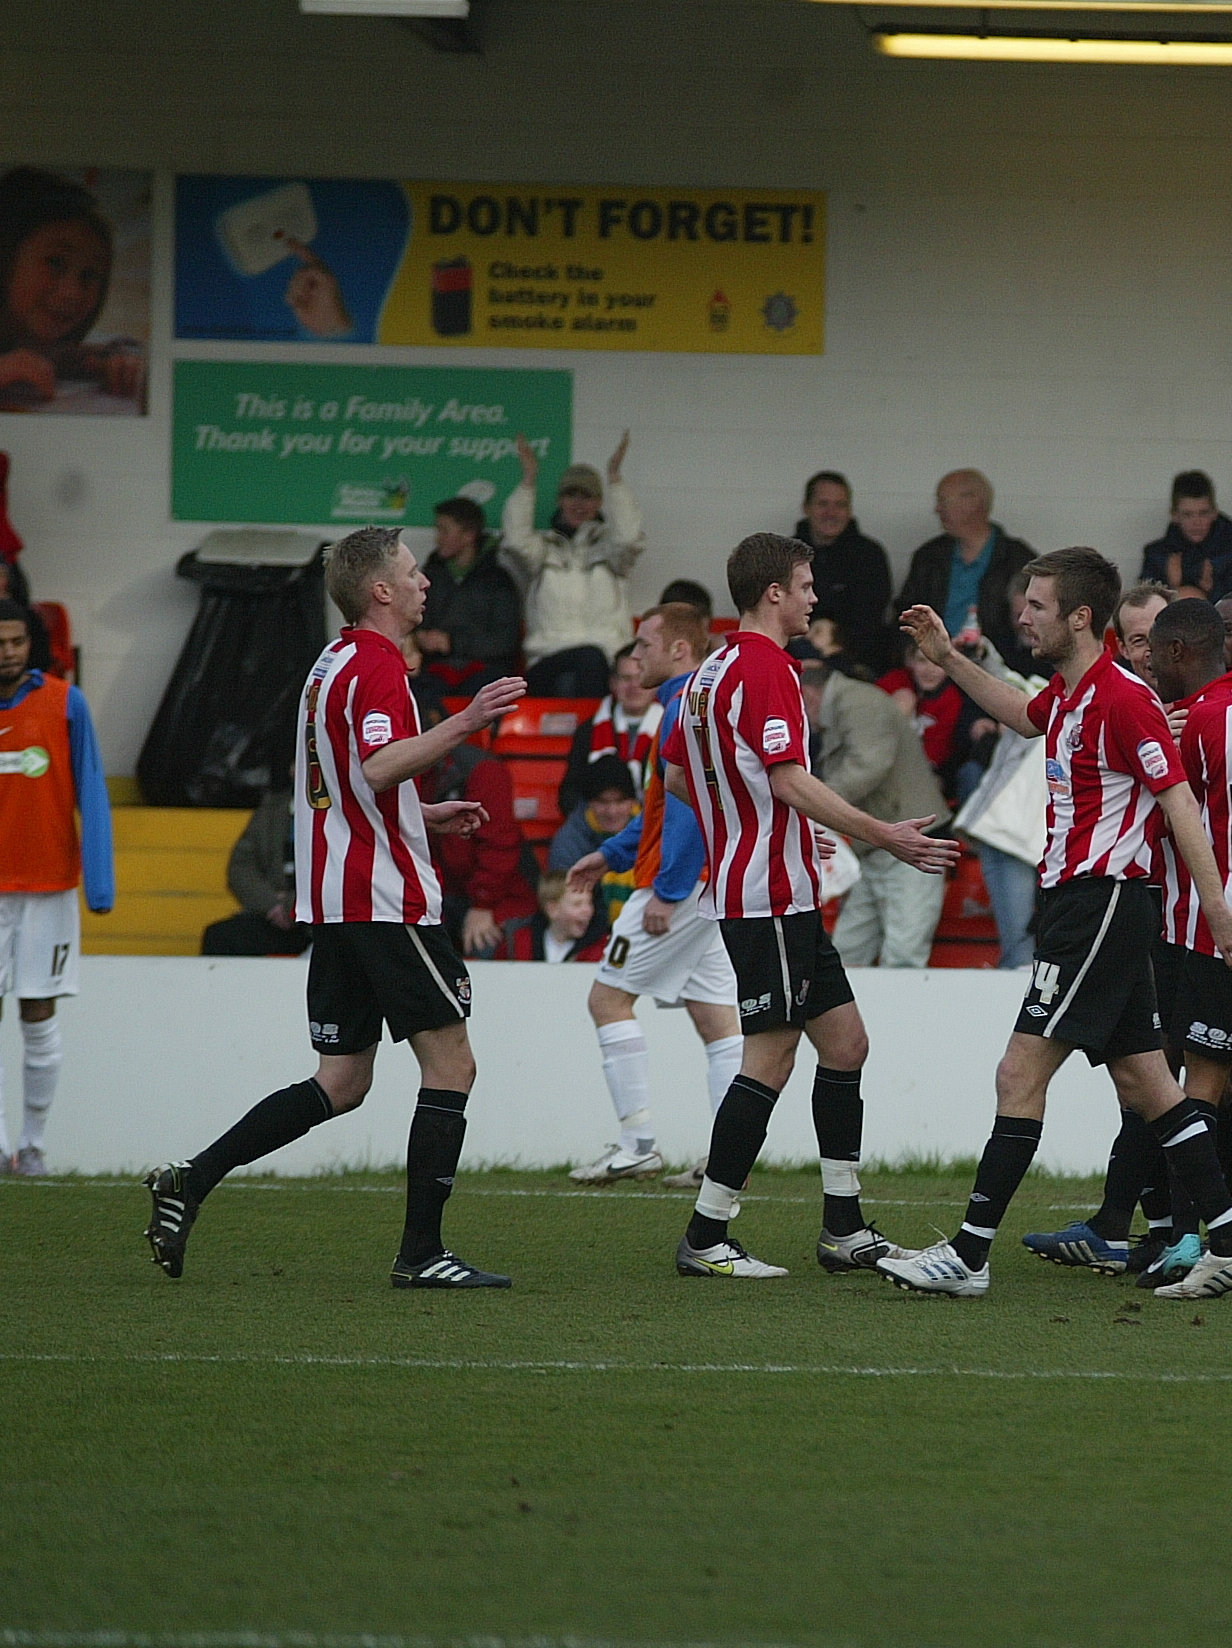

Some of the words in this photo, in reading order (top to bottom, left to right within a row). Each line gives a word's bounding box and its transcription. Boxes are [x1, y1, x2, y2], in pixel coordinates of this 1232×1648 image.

[428, 194, 584, 238] DON'T
[598, 200, 815, 244] FORGET!
[488, 261, 559, 281] Check
[566, 263, 604, 281] the
[488, 288, 571, 309] battery
[575, 290, 600, 307] in
[605, 292, 657, 310] your
[488, 314, 565, 331] smoke
[571, 315, 638, 332] alarm
[235, 393, 287, 420] This
[292, 395, 313, 421] is
[320, 402, 338, 421] a
[345, 395, 434, 428] Family
[195, 425, 276, 451] Thank
[279, 432, 332, 459] you
[338, 429, 375, 453] for
[382, 435, 445, 460] your
[51, 942, 70, 977] 17
